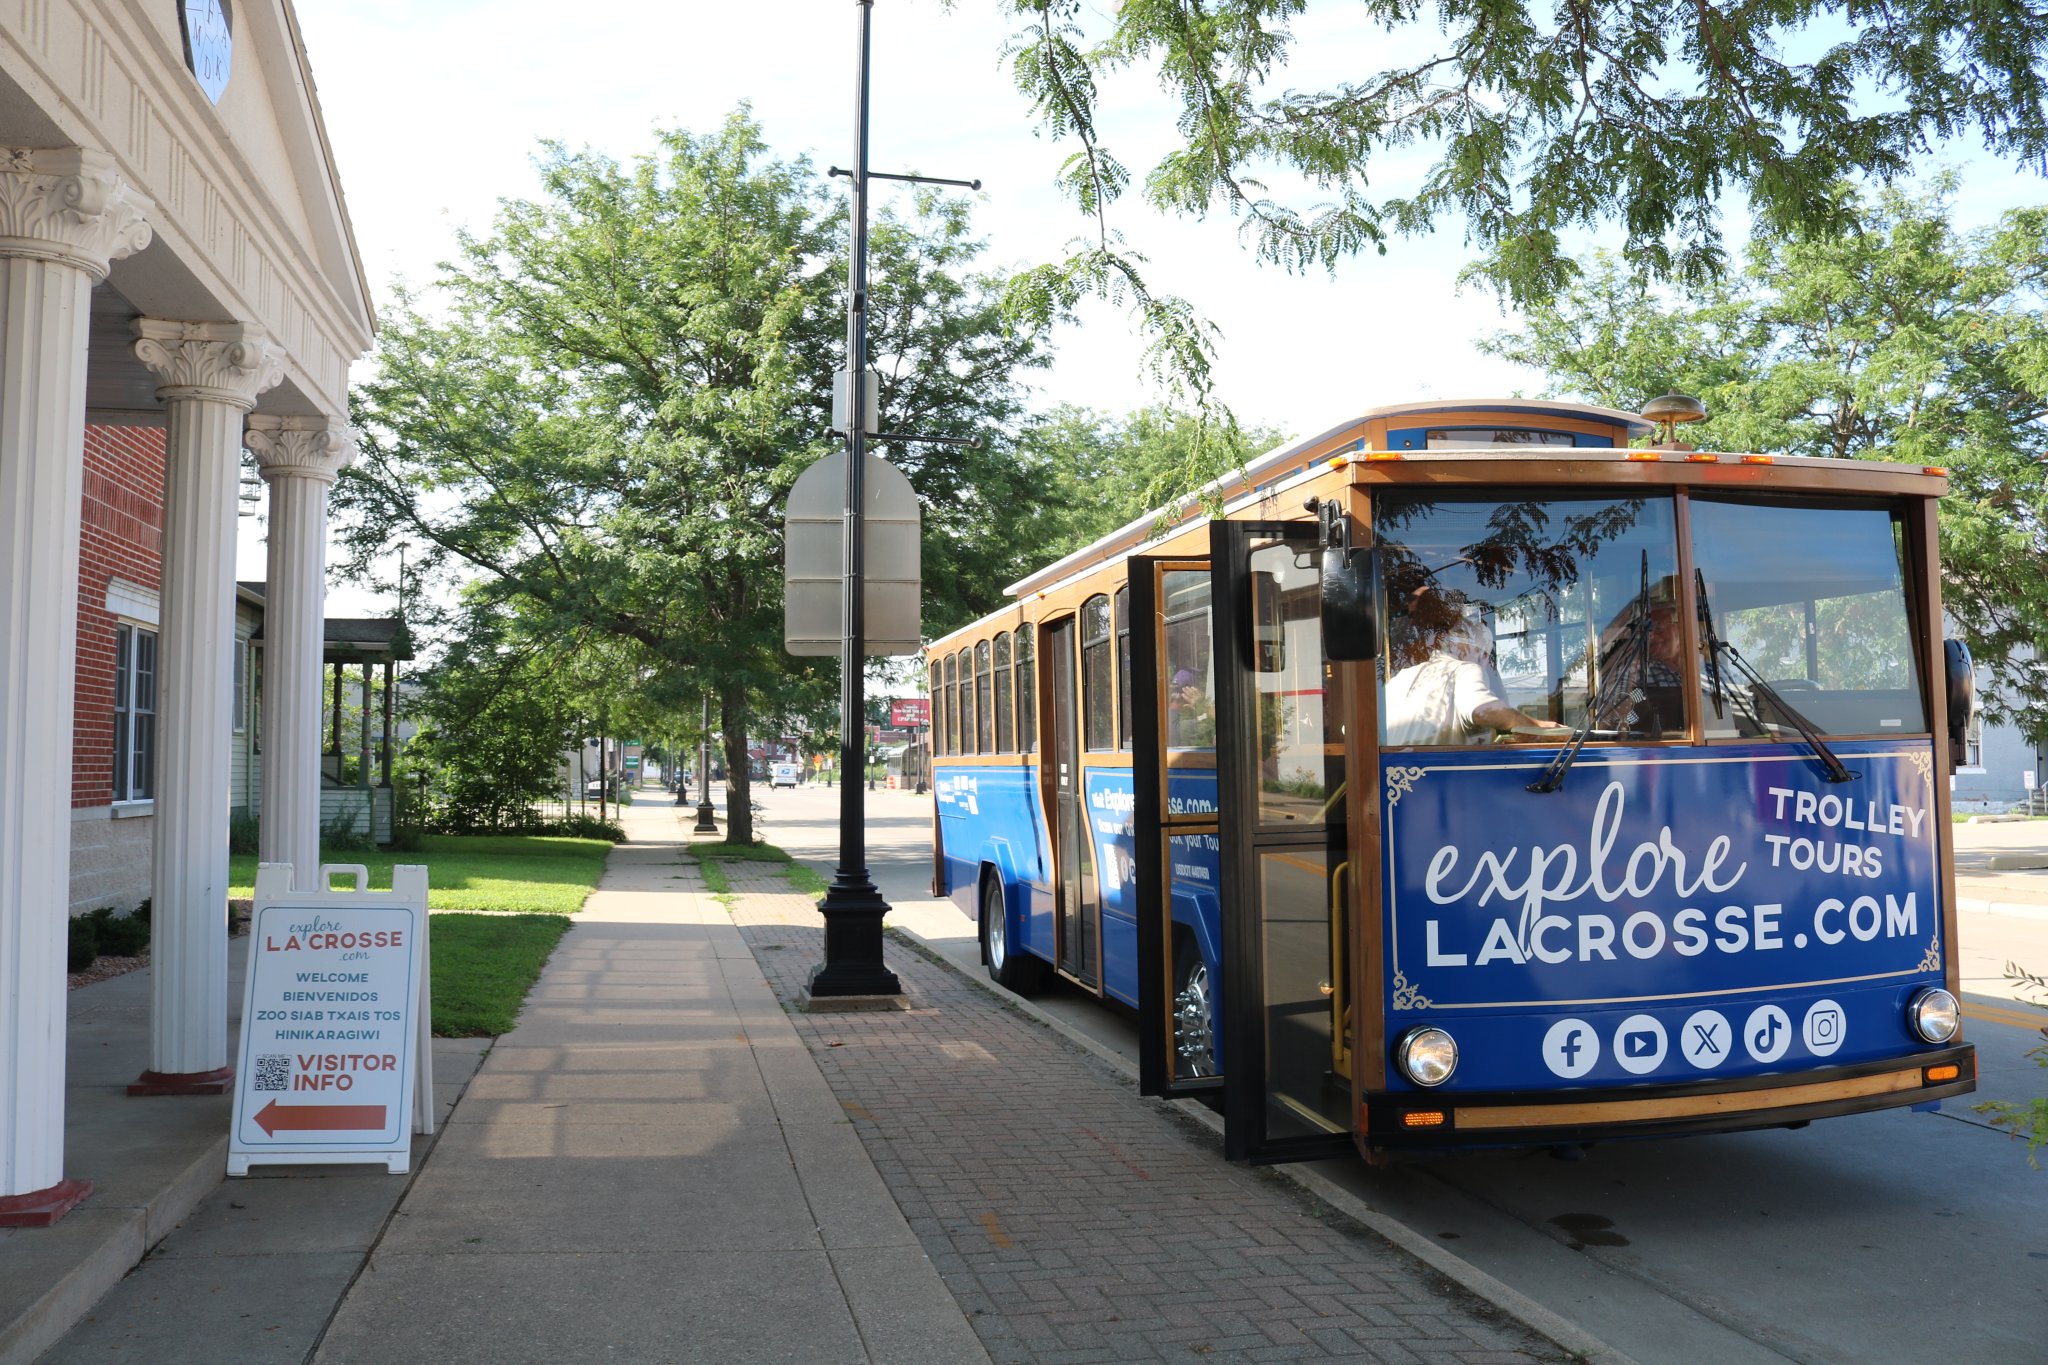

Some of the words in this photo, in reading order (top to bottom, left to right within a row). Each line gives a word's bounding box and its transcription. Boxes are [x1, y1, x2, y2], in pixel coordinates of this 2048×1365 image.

[1768, 787, 1926, 838] TROLLEY
[1764, 834, 1883, 879] TOURS
[1425, 781, 1747, 961] explore
[289, 914, 343, 941] explore
[1426, 892, 1918, 967] LACROSSE.COM
[339, 950, 370, 961] .com
[296, 972, 369, 983] WELCOME
[283, 991, 378, 1001] BIENVENIDOS
[256, 1010, 287, 1021] ZOO
[290, 1010, 324, 1021] SIAB
[327, 1011, 370, 1021] TXAIS
[374, 1011, 401, 1021] TOS
[275, 1030, 380, 1040] HINIKARAGIWI
[297, 1054, 397, 1071] VISITOR
[294, 1074, 354, 1092] INFO
